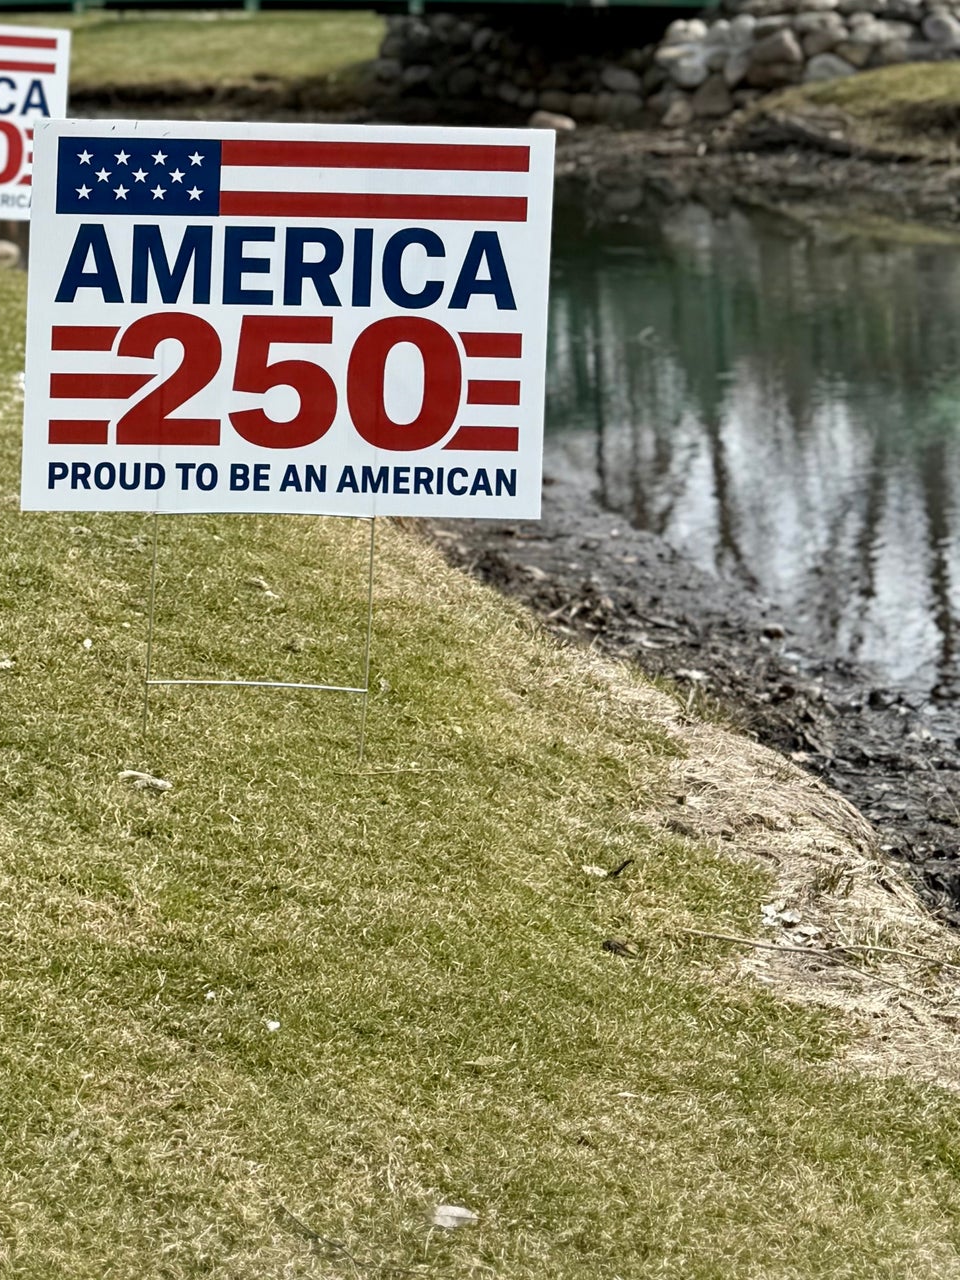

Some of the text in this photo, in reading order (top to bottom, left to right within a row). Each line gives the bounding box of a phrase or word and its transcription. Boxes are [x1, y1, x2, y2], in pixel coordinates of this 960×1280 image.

[54, 223, 517, 310] AMERICA
[116, 311, 462, 452] 250
[47, 461, 517, 497] PROUD TO BE AN AMERICAN
